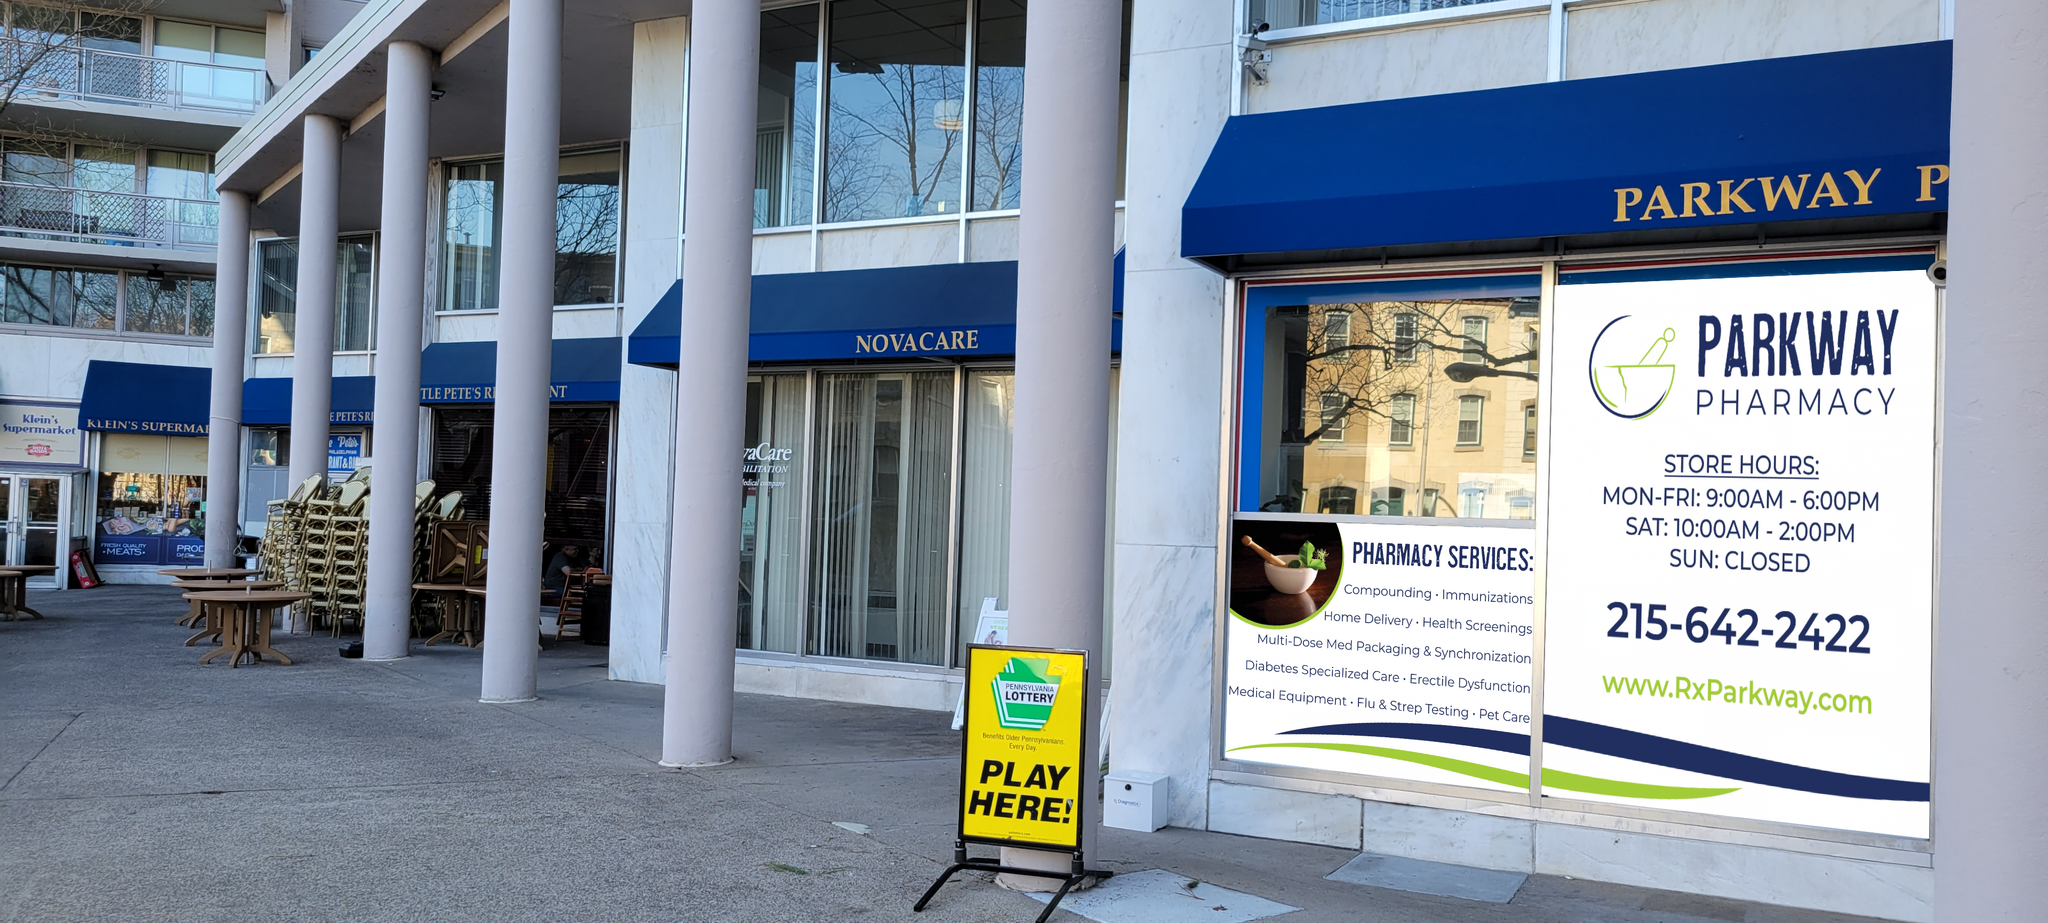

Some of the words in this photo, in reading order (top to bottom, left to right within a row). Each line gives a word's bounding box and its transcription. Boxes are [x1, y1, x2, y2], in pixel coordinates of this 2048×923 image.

[1613, 168, 1882, 222] PARKWAY
[855, 329, 979, 354] NOVACARE
[1697, 309, 1899, 378] PARKWAY
[443, 386, 481, 400] PETE'S
[1696, 387, 1896, 416] PHARMACY
[3, 423, 77, 435] Supermarket
[23, 413, 58, 424] Klein's
[87, 419, 138, 430] KLEIN'S
[336, 411, 364, 422] PETE'S
[1664, 453, 1733, 475] STORE
[1740, 455, 1820, 476] HOURS:
[1603, 486, 1701, 508] MON-FRI:
[1706, 488, 1783, 510] 9:00AM
[1802, 490, 1879, 512] 6:00PM
[1625, 516, 1668, 537] SAT:
[1673, 517, 1759, 540] 10:00AM
[1778, 520, 1855, 543] 2:00PM
[1352, 541, 1443, 568] PHARMACY
[1447, 545, 1534, 572] SERVICES:
[1669, 548, 1719, 570] SUN:
[1724, 550, 1811, 573] CLOSED
[1343, 583, 1432, 602] Compounding
[1442, 588, 1534, 605] Immunizations
[1323, 610, 1361, 624] Home
[1364, 612, 1413, 629] Delivery
[1422, 616, 1462, 630] Health
[1465, 619, 1533, 637] Screenings
[1606, 601, 1871, 655] 215-642-2422
[1257, 633, 1323, 649] Multi-Dose
[1326, 638, 1353, 651] Med
[1356, 640, 1420, 659] Packaging
[1423, 645, 1432, 657] &
[1434, 646, 1532, 664] Synchronization
[1005, 683, 1055, 693] PENNSYLVANIA
[1245, 659, 1299, 675] Diabetes
[1301, 664, 1369, 681] Specialized
[1372, 669, 1400, 683] Care
[1409, 672, 1455, 688] Erectile
[1458, 676, 1531, 694] Dysfunction
[1005, 690, 1054, 703] LOTTERY
[1228, 685, 1275, 700] Medical
[1278, 689, 1347, 707] Equipment
[1357, 697, 1376, 710] Flu
[1378, 699, 1387, 710] &
[1389, 700, 1423, 716] Strep
[1425, 703, 1469, 721] Testing
[1479, 708, 1500, 721] Pet
[1502, 710, 1531, 724] Care
[1602, 675, 1872, 715] www.RxParkway.com
[982, 732, 1005, 740] Benefits
[1008, 743, 1025, 751] Every
[979, 759, 1072, 791] PLAY
[967, 790, 1074, 824] HERE!
